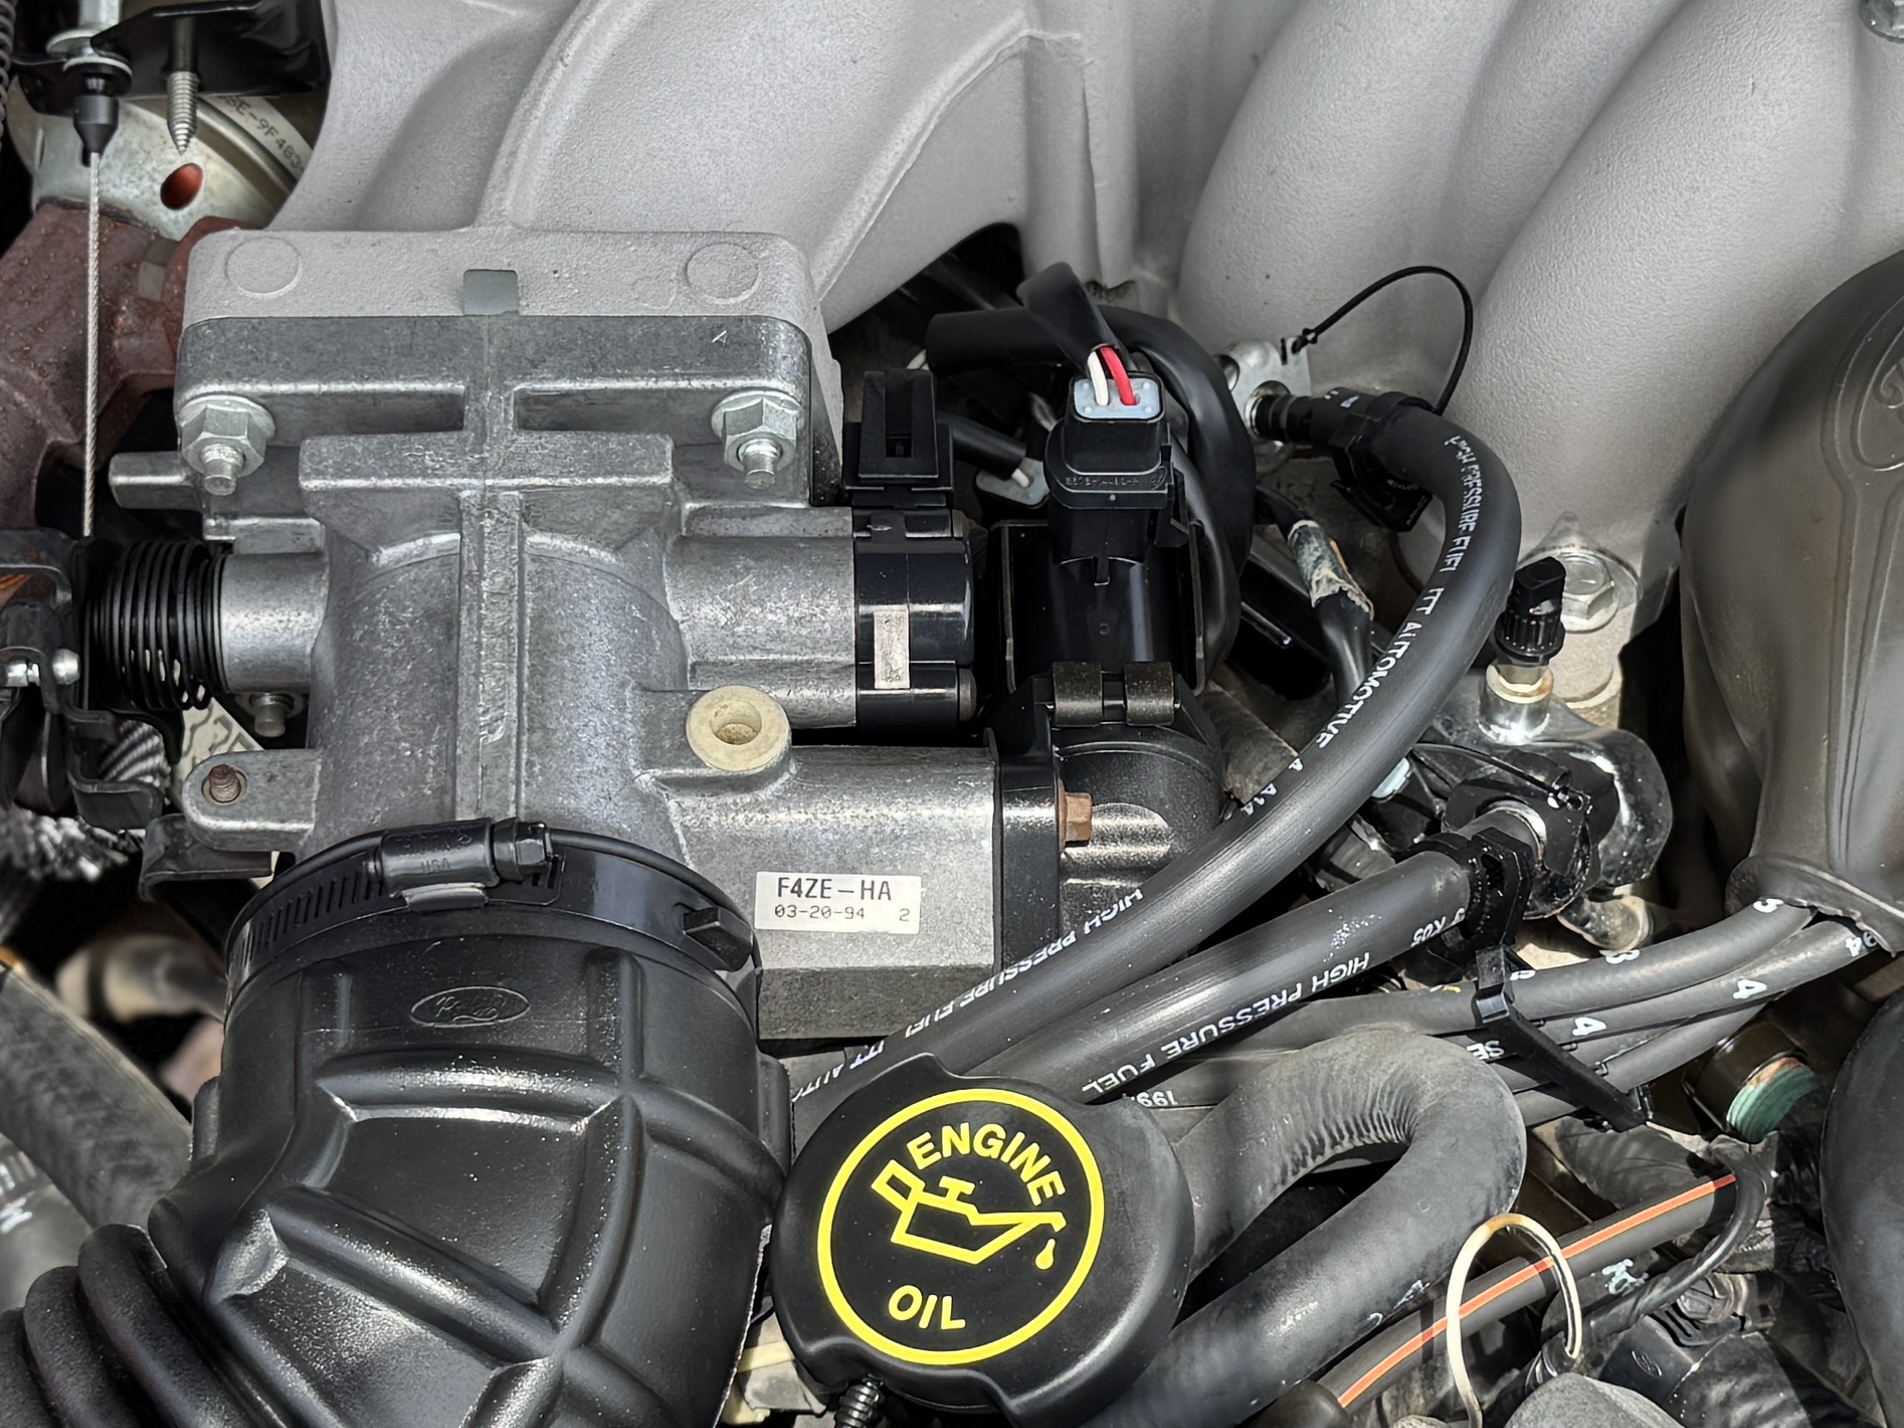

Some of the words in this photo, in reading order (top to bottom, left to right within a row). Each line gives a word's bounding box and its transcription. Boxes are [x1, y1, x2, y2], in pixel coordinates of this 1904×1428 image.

[773, 904, 866, 922] 03-20-94
[897, 907, 911, 923] 2
[1313, 952, 1371, 990] HIGH
[1159, 981, 1305, 1061] PRESSURE
[1080, 1054, 1159, 1096] FUEL
[906, 1122, 1066, 1206] ENGINE
[887, 1283, 967, 1331] OIL
